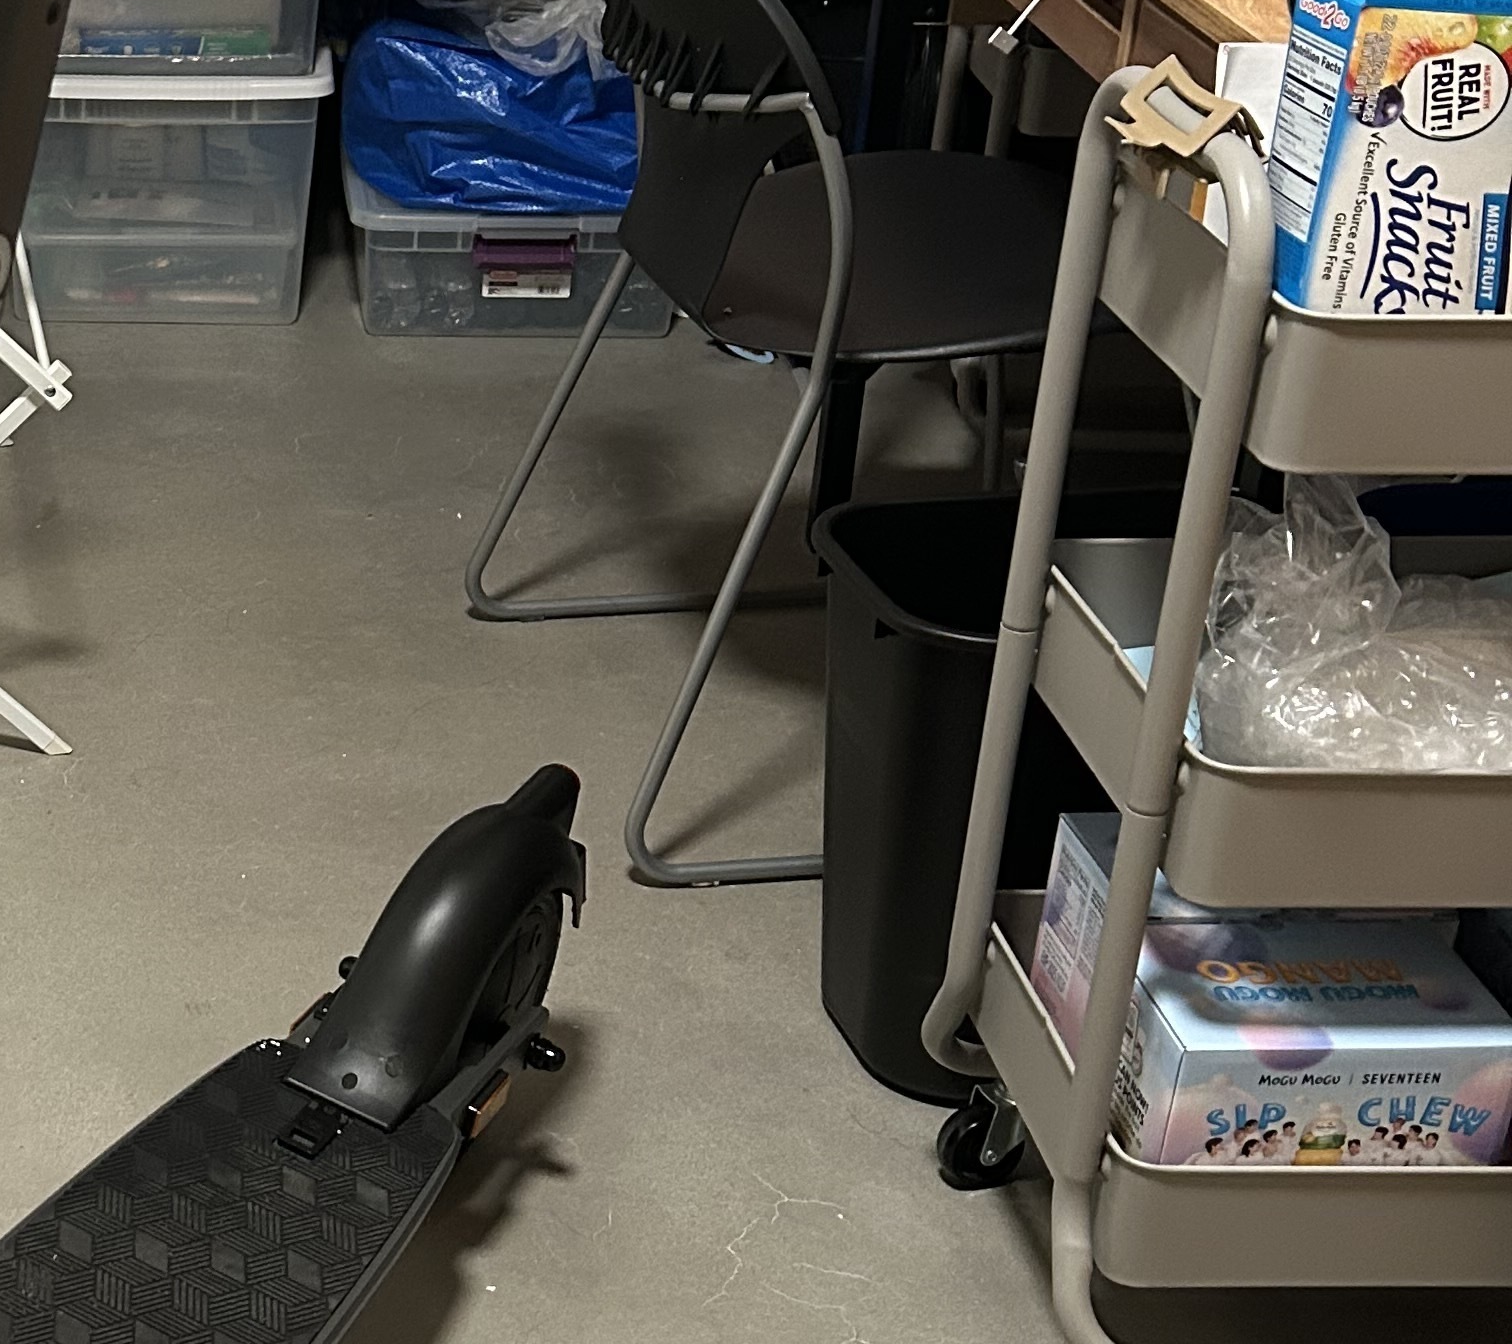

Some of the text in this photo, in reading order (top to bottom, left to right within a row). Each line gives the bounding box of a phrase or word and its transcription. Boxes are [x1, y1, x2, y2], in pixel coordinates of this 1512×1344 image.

[1290, 39, 1319, 64] Nutrition
[1320, 56, 1342, 76] Facts
[1321, 102, 1333, 118] 70
[1431, 58, 1454, 131] FRUIT!
[1458, 63, 1481, 120] REAL
[1322, 212, 1347, 281] Gluten Free
[1332, 141, 1380, 309] Excellent Source of Vitamins
[1375, 158, 1438, 314] Snack
[1422, 192, 1470, 310] Fruit
[1479, 204, 1500, 301] MIXED FRUIT
[1196, 959, 1403, 984] MANGO
[1362, 1072, 1441, 1085] SEVENTEEN
[1206, 1096, 1491, 1136] SIP CHEW
